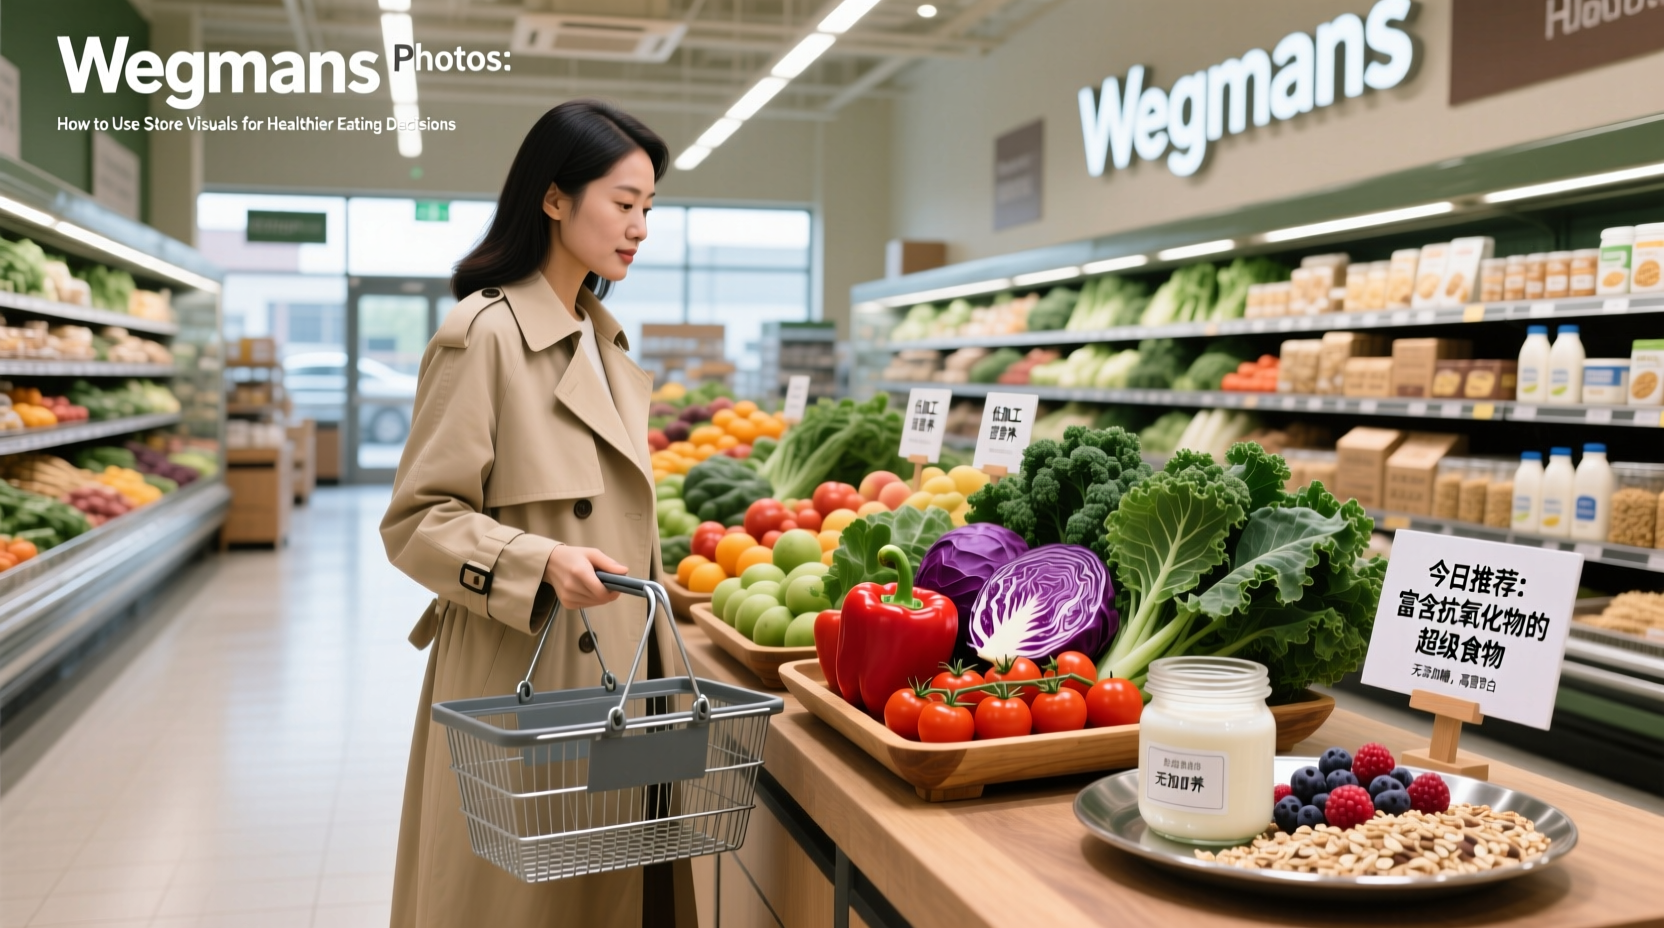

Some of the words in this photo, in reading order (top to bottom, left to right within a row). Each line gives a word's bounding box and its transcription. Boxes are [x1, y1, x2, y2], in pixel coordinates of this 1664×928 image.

[1078, 0, 1413, 177] Wegmans
[1397, 589, 1550, 642] 富含抗氧化物的
[1415, 626, 1506, 670] 超级食物
